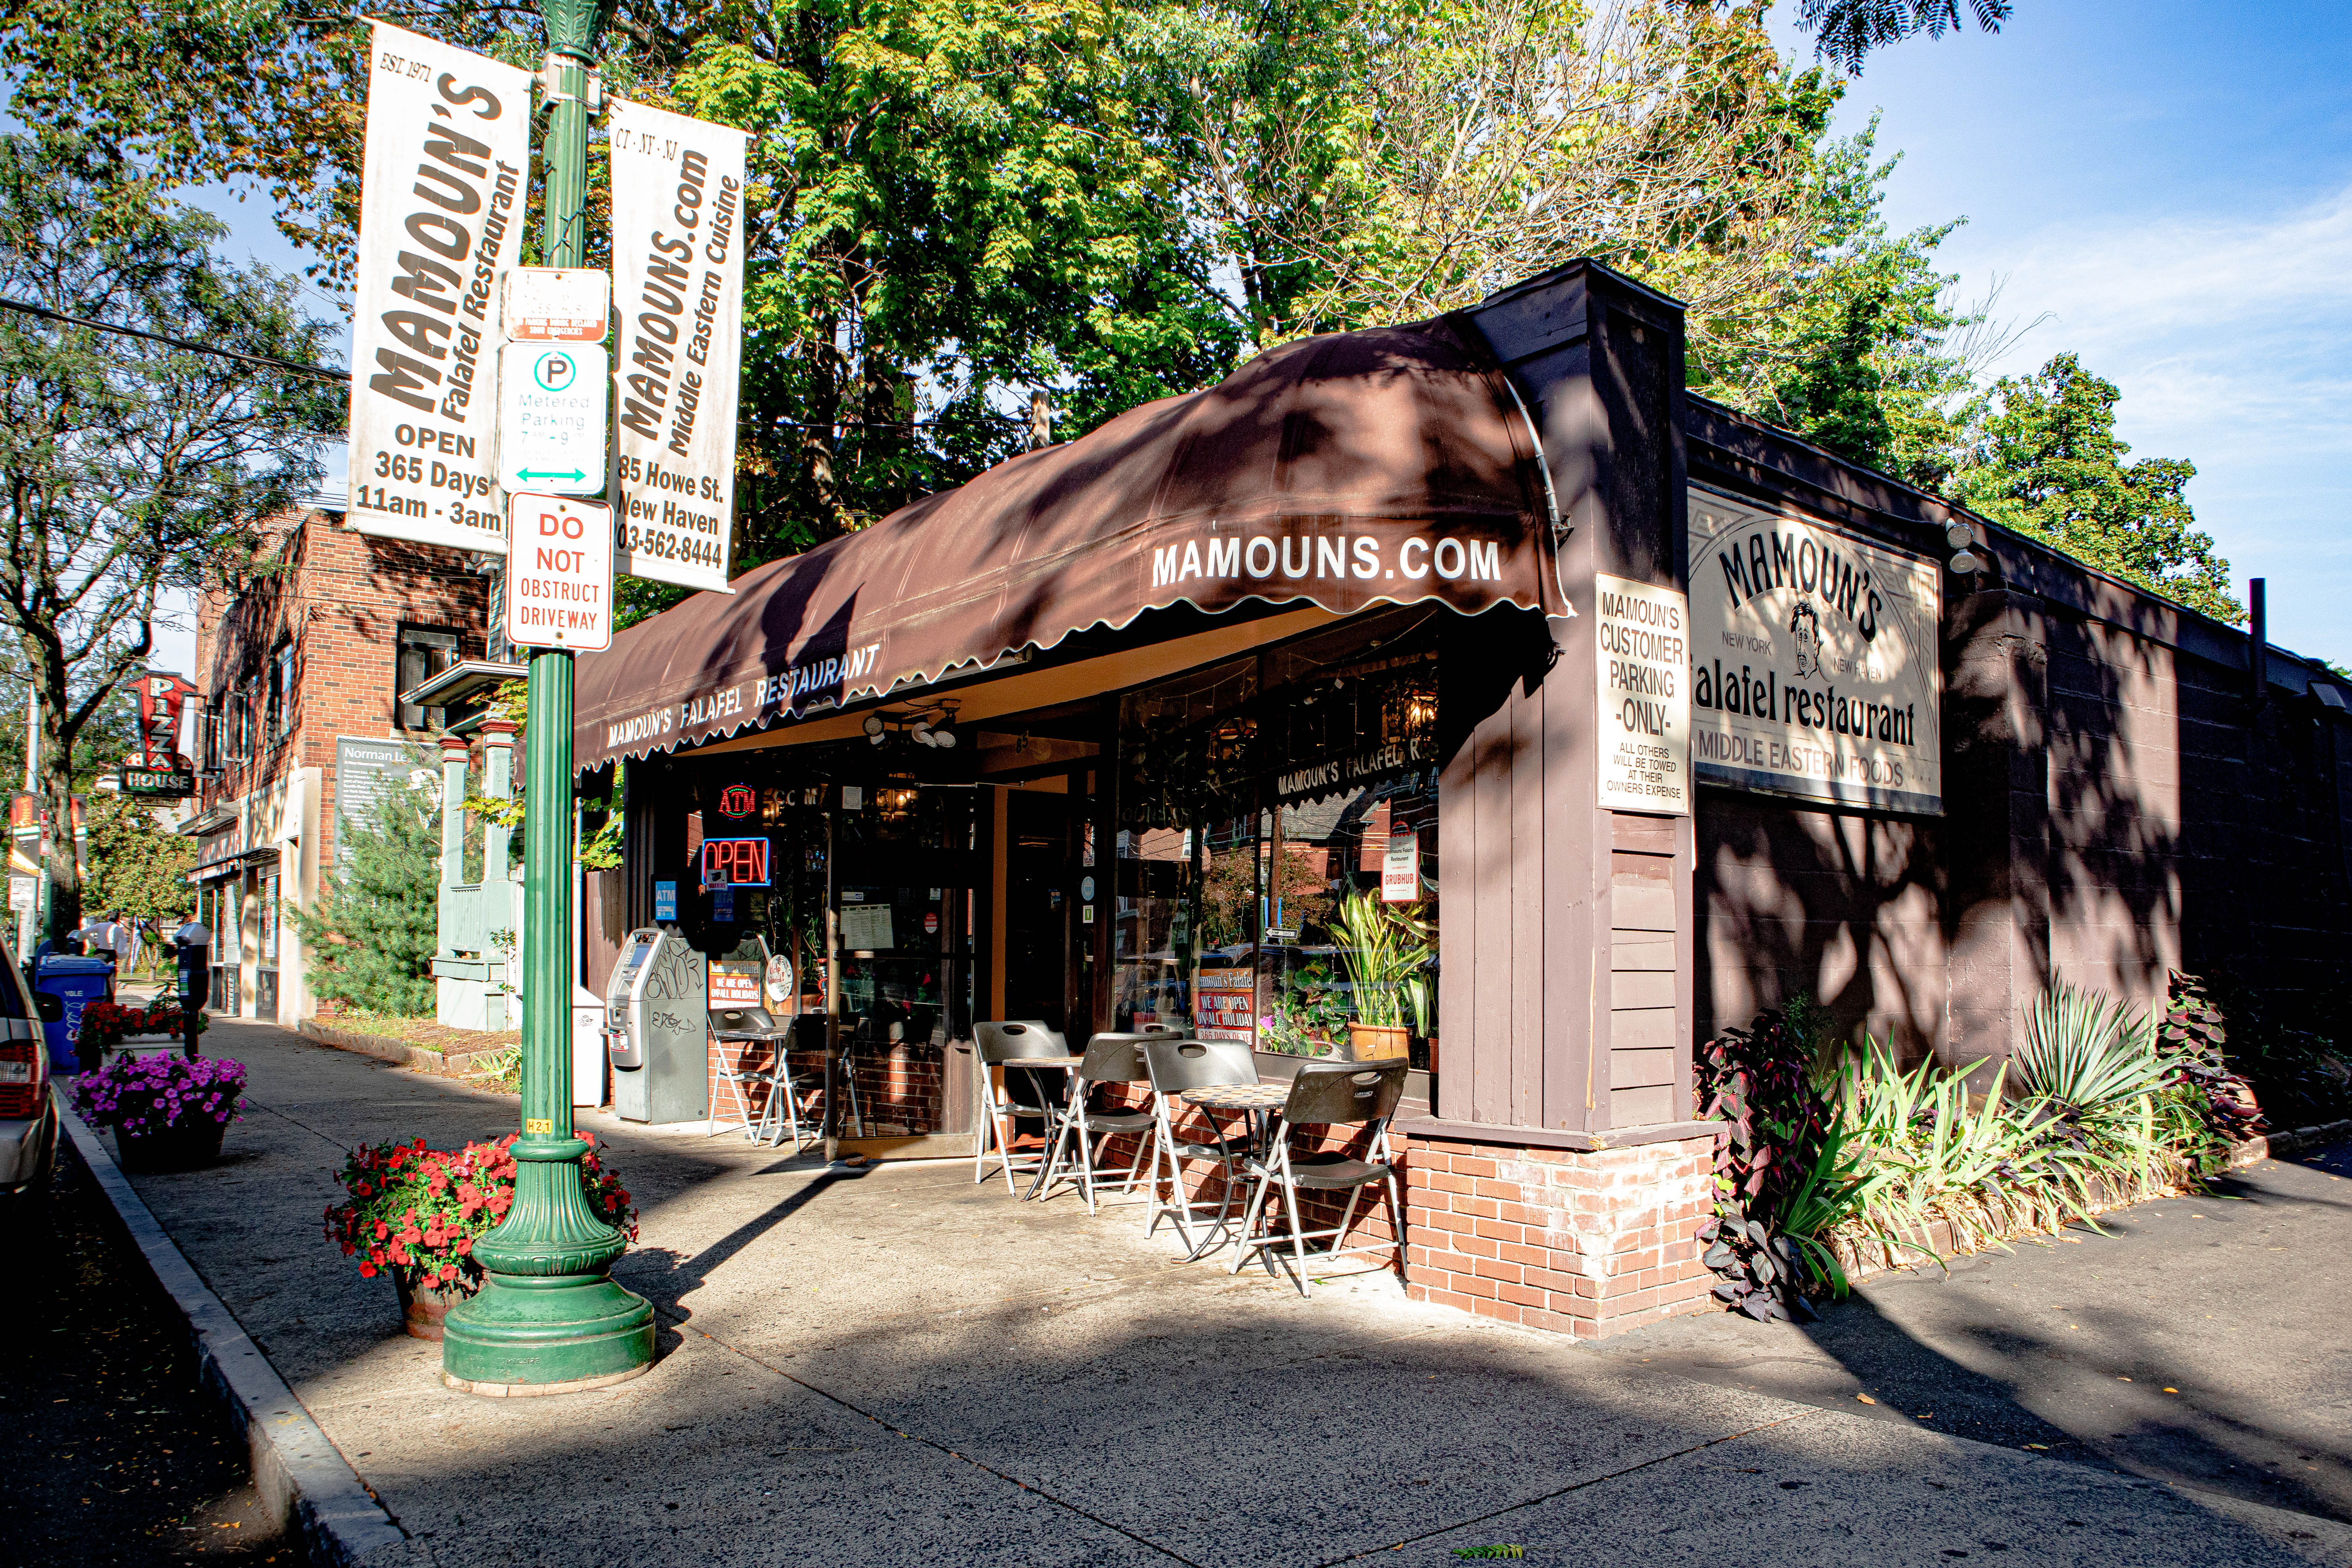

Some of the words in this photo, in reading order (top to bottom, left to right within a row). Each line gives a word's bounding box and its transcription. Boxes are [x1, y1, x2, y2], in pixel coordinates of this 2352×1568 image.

[406, 61, 431, 82] 1971
[616, 128, 630, 149] CT
[639, 133, 655, 155] NY
[663, 140, 677, 161] NJ
[369, 73, 502, 413] MAMOUN'S
[441, 321, 482, 423] Falafel
[463, 160, 519, 321] Restaurant
[620, 150, 708, 441] MAMOUNS.com
[668, 371, 702, 457] Middle
[686, 271, 722, 367] Eastern
[706, 175, 739, 264] Cuisine
[548, 360, 567, 383] P
[519, 394, 589, 408] Metered
[522, 413, 584, 430] Parking
[395, 424, 475, 458] OPEN
[375, 451, 422, 483] 365
[431, 461, 489, 499] Days
[618, 455, 641, 482] 85
[646, 461, 696, 495] Howe
[701, 476, 723, 503] St.
[357, 485, 427, 518] 11am
[450, 501, 501, 532] 3am
[617, 490, 657, 521] New
[663, 500, 718, 535] Haven
[540, 514, 583, 539] DO
[615, 521, 722, 569] 03-562-8444
[537, 548, 584, 573] NOT
[1152, 536, 1501, 588] MAMOUNS.COM
[521, 578, 599, 603] OBSTRUCT
[1719, 532, 1882, 643] MAMOUN'S
[521, 606, 597, 630] DRIVEWAY
[1602, 592, 1679, 630] MAMOUN'S
[1601, 622, 1682, 664] CUSTOMER
[1722, 632, 1744, 648] NEW
[1746, 637, 1771, 656] YORK
[1610, 660, 1674, 698] PARKING
[1834, 657, 1852, 673] NEW
[1855, 660, 1882, 681] HAVEN
[607, 710, 672, 748] MAMOUN'S
[680, 688, 743, 728] FALAFEL
[755, 644, 880, 707] RESTAURANT
[1690, 653, 1777, 721] alafel
[1784, 686, 1914, 746] restaurant
[149, 677, 174, 768] PIZZA
[1616, 698, 1670, 736] -ONLY-
[345, 747, 392, 761] Norman
[1620, 742, 1635, 754] ALL
[1638, 745, 1669, 759] OTHERS
[1699, 729, 1764, 766] MIDDLE
[1770, 742, 1844, 777] EASTERN
[1850, 756, 1904, 788] FOODS
[1278, 761, 1339, 795] MAMOUN'S
[1347, 744, 1403, 778] FALAFEL
[1613, 755, 1633, 767] WILL
[1636, 757, 1646, 768] BE
[1649, 759, 1676, 772] TOWED
[126, 772, 189, 789] HOUSE
[1607, 780, 1643, 795] OWNERS
[1646, 784, 1681, 799] EXPENSE
[1628, 770, 1639, 780] AT
[1639, 771, 1662, 784] THEIR
[719, 790, 756, 812] ATM
[704, 840, 766, 882] OPEN
[1385, 873, 1413, 885] GRUBHUB
[656, 890, 675, 902] ATM
[711, 962, 739, 973] Mamoun's
[740, 963, 759, 974] Falafel
[769, 962, 780, 975] Help
[1192, 971, 1227, 989] Mamoun's
[1228, 971, 1253, 988] Falafel
[716, 978, 724, 987] WE
[725, 978, 736, 988] ARE
[737, 978, 753, 989] OPEN
[720, 989, 730, 998] ALL
[731, 989, 759, 1000] HOLIDAYS
[1201, 996, 1212, 1009] WE
[1214, 996, 1227, 1009] ARE
[1229, 996, 1249, 1010] OPEN
[1196, 1011, 1207, 1024] ON
[1209, 1012, 1221, 1025] ALL
[1222, 1012, 1253, 1027] HOLIDAY
[1201, 1031, 1212, 1040] 365
[528, 1122, 549, 1131] H21
